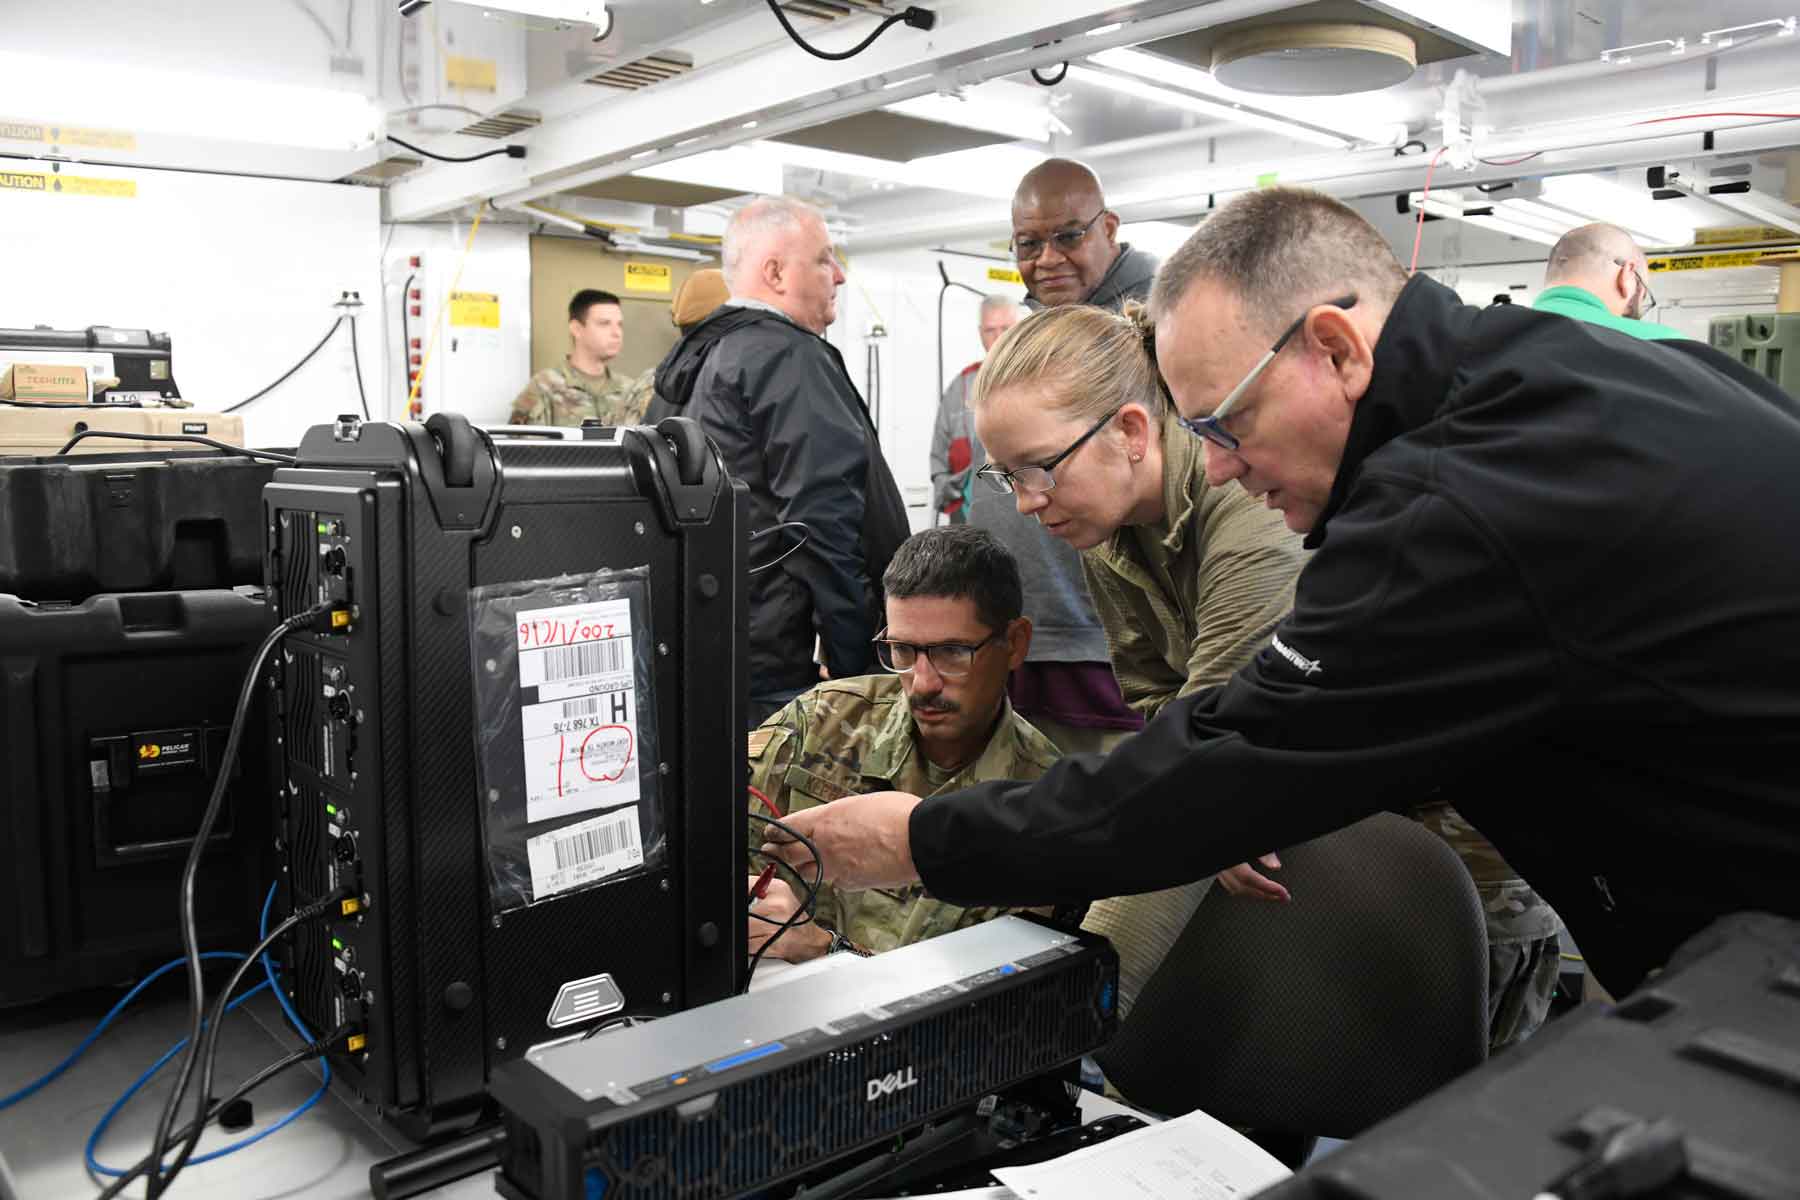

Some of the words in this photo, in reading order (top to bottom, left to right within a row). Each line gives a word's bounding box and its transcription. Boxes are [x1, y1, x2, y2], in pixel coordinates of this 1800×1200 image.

[0, 174, 43, 189] AUTION
[611, 691, 627, 723] H
[589, 715, 600, 727] TX
[867, 1065, 918, 1101] DELL
